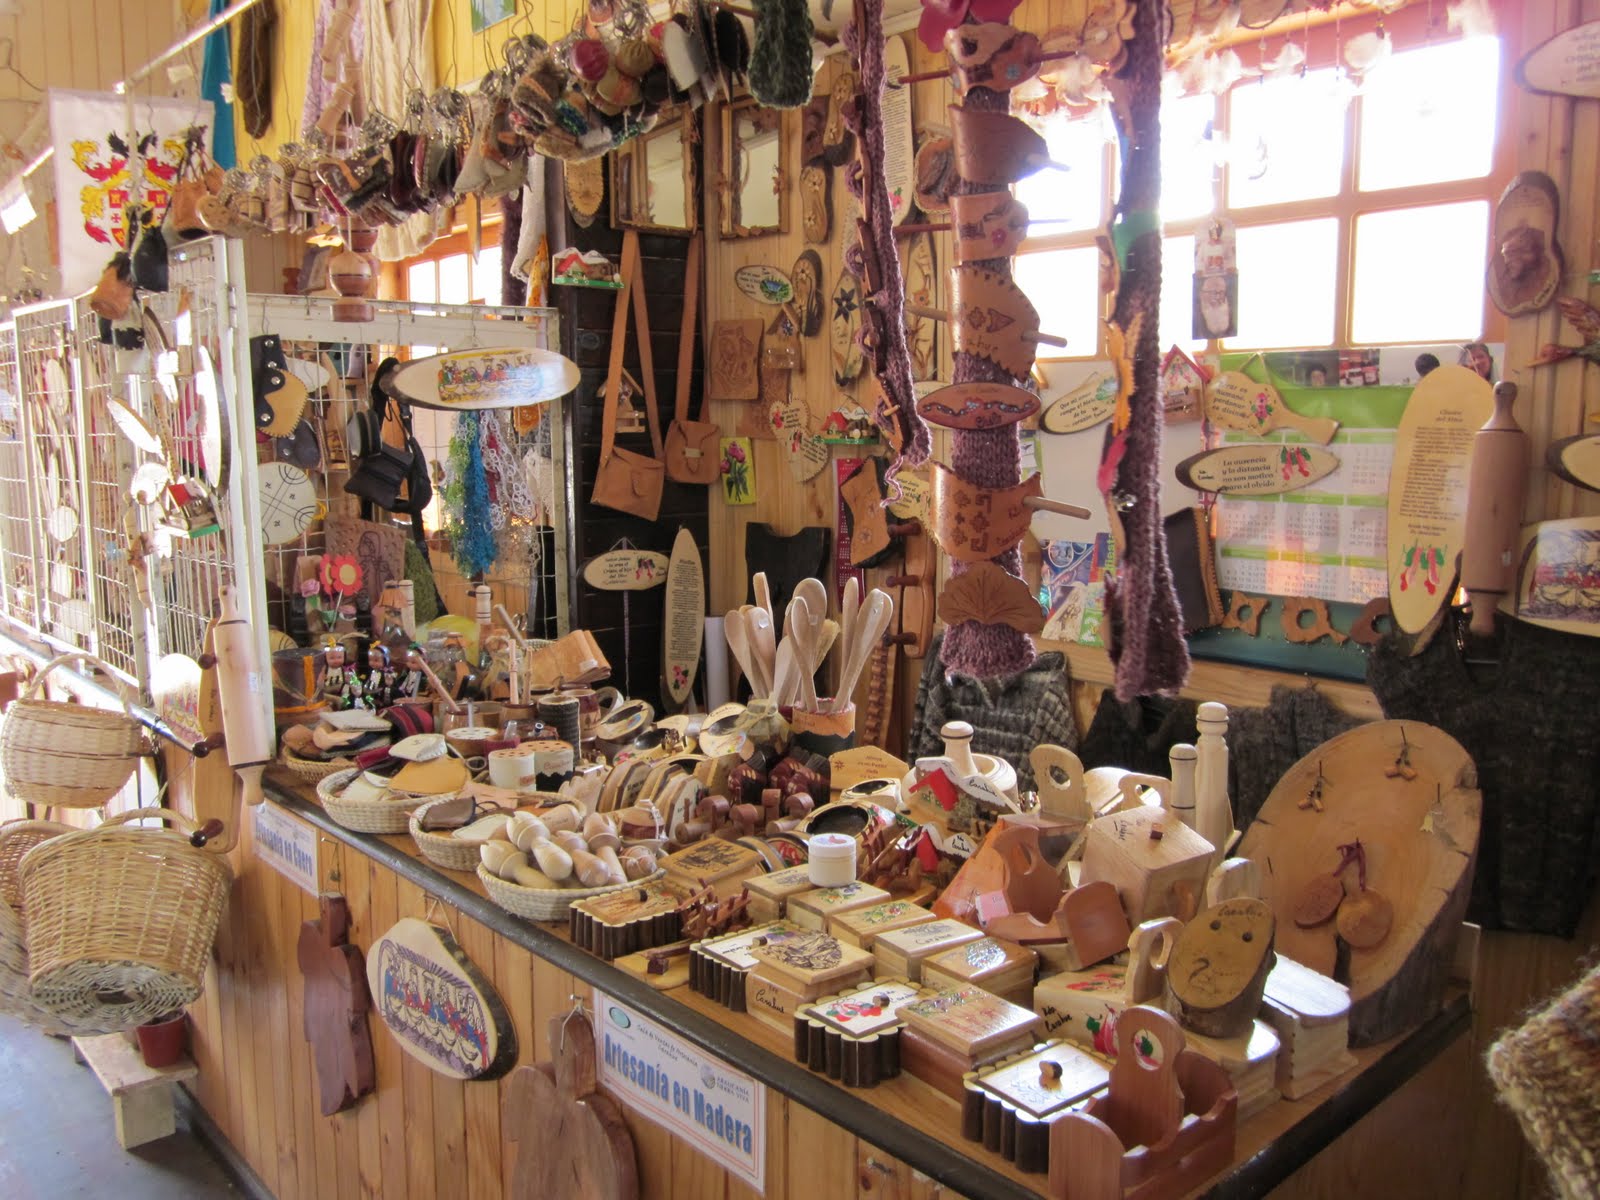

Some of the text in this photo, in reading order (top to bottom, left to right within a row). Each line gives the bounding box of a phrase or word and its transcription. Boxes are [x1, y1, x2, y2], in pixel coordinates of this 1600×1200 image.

[1234, 457, 1267, 465] ausencia
[1237, 465, 1271, 473] distancia
[1248, 472, 1274, 480] motivo
[1252, 480, 1275, 488] olvido
[604, 1031, 753, 1155] Artesanía en Madera
